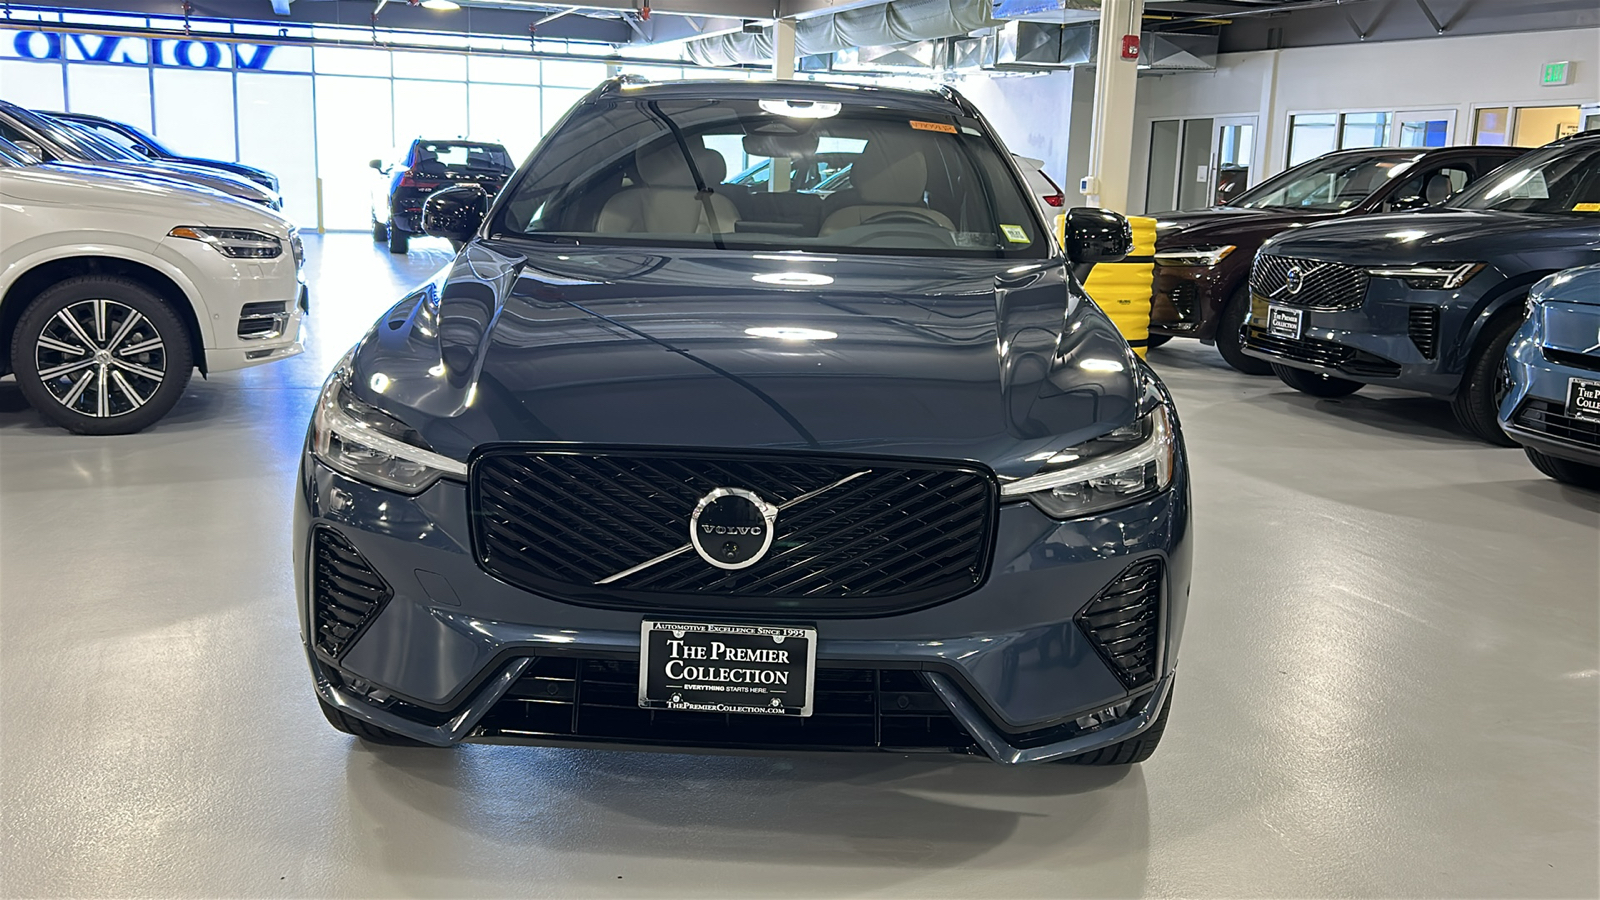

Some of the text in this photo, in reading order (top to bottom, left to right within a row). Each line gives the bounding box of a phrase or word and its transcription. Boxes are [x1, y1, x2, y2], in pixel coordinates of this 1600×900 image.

[1578, 387, 1594, 398] THE
[701, 524, 762, 536] VOLVO
[655, 622, 804, 637] AUTOMOTIVE EXCELLENCE SINCE 1995
[666, 639, 790, 664] THE PREMIER
[665, 659, 789, 685] COLLECTION
[683, 684, 725, 692] EVERYTHING
